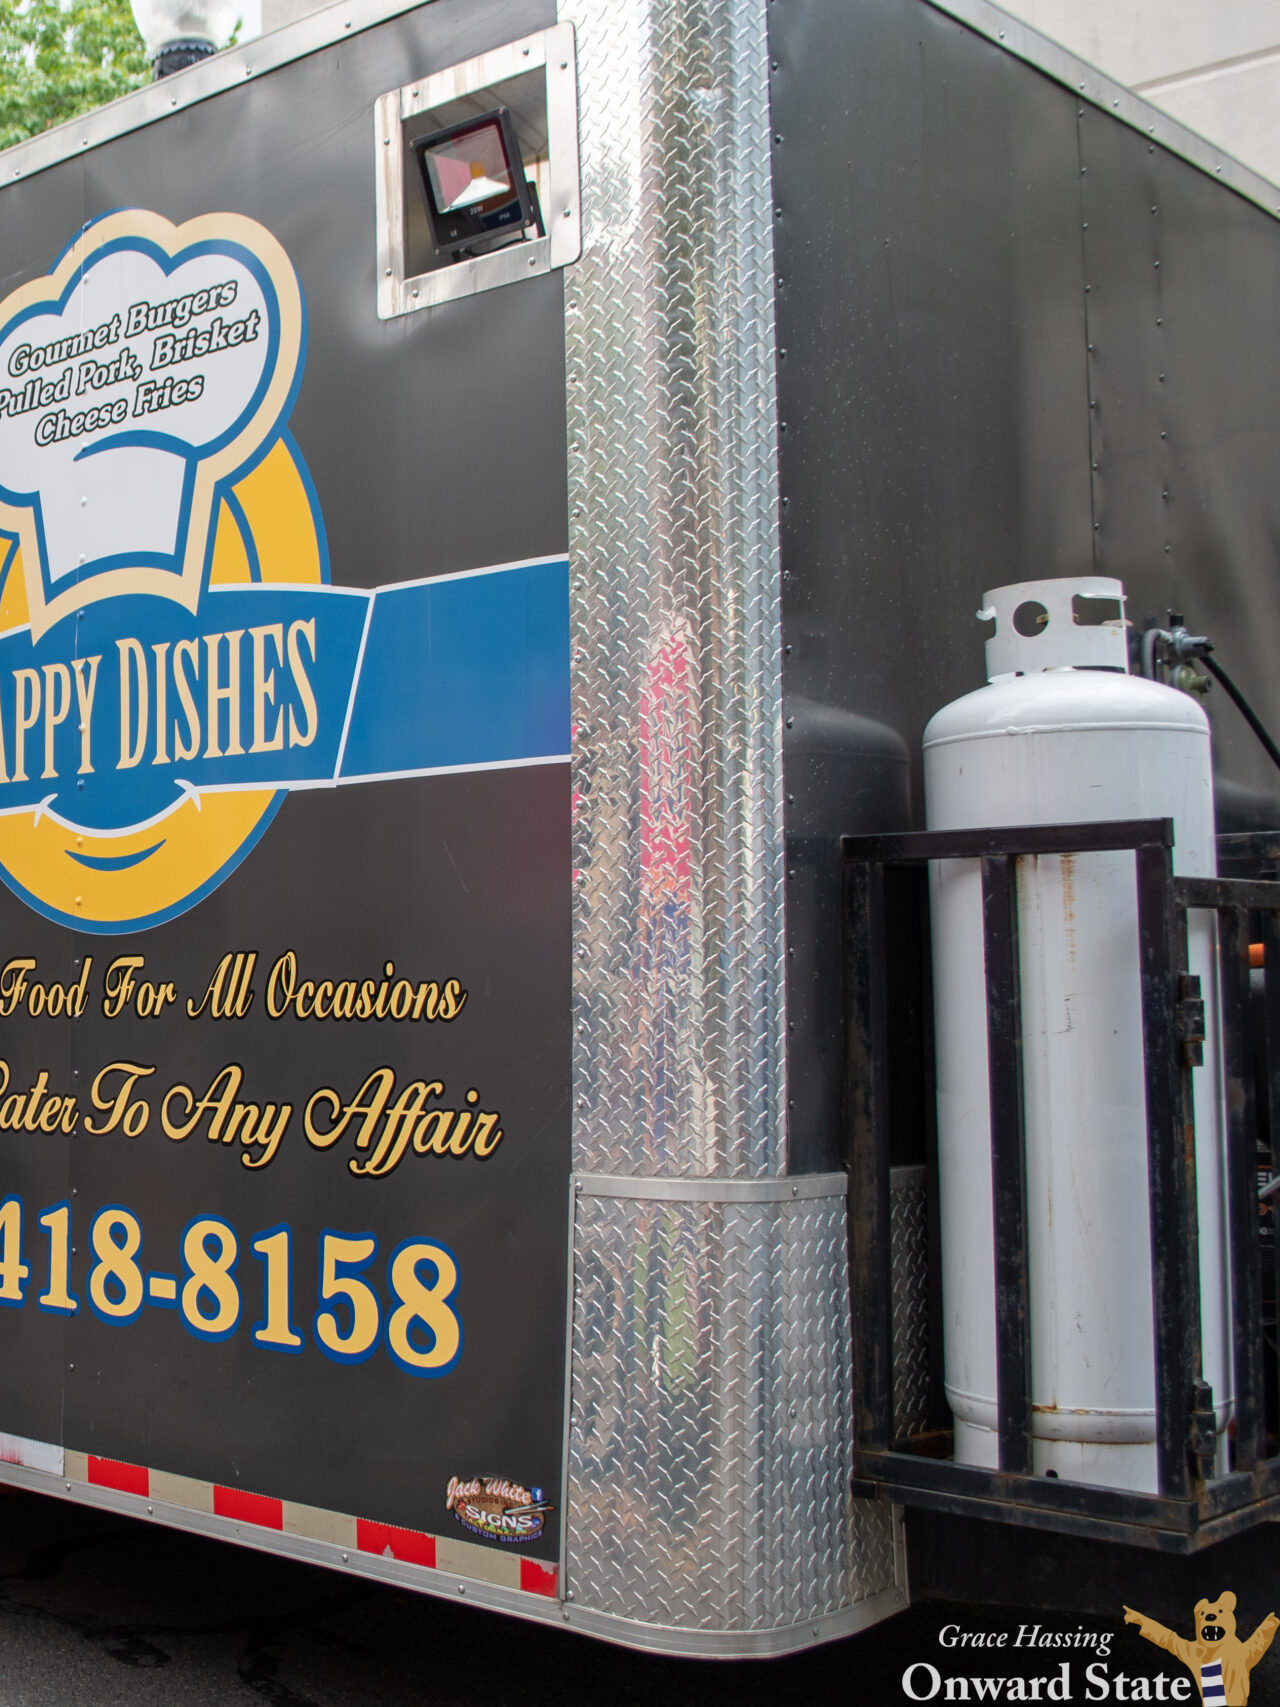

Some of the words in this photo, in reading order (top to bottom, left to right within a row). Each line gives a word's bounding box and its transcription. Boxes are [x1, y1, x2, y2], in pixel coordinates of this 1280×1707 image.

[8, 314, 120, 377] Gourmet
[125, 280, 238, 338] Burgers
[77, 348, 143, 395] Pork,
[150, 310, 260, 371] Brisket
[35, 398, 127, 447] Cheese
[133, 375, 204, 417] Fries
[115, 617, 318, 770] DISHES
[103, 957, 177, 1018] For
[187, 952, 257, 1018] All
[266, 951, 467, 1020] Occasions
[83, 1060, 156, 1136] To
[161, 1065, 291, 1167] Any
[304, 1067, 503, 1176] Affair
[446, 1476, 481, 1510] Jack
[482, 1478, 532, 1505] White
[465, 1504, 533, 1528] SIGNS
[461, 1519, 497, 1540] CUSTOM
[500, 1529, 543, 1543] GRAPHICS
